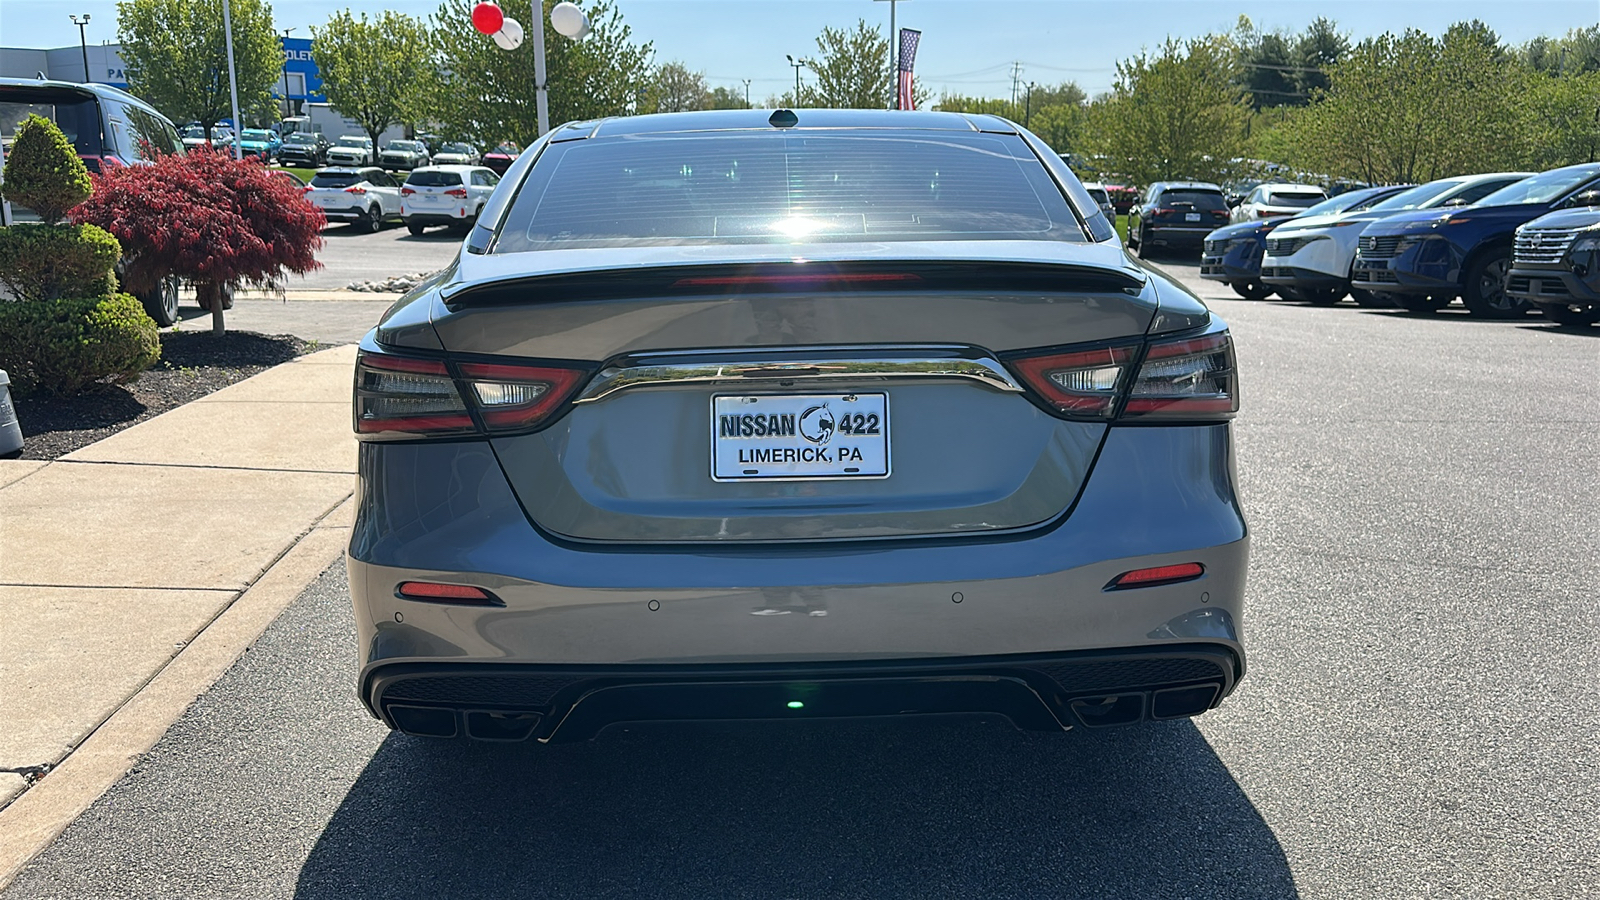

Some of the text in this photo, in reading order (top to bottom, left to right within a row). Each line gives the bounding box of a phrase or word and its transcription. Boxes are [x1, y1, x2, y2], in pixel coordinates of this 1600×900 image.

[720, 412, 881, 438] NISSAN 422
[739, 447, 863, 465] LIMERICK, PA
